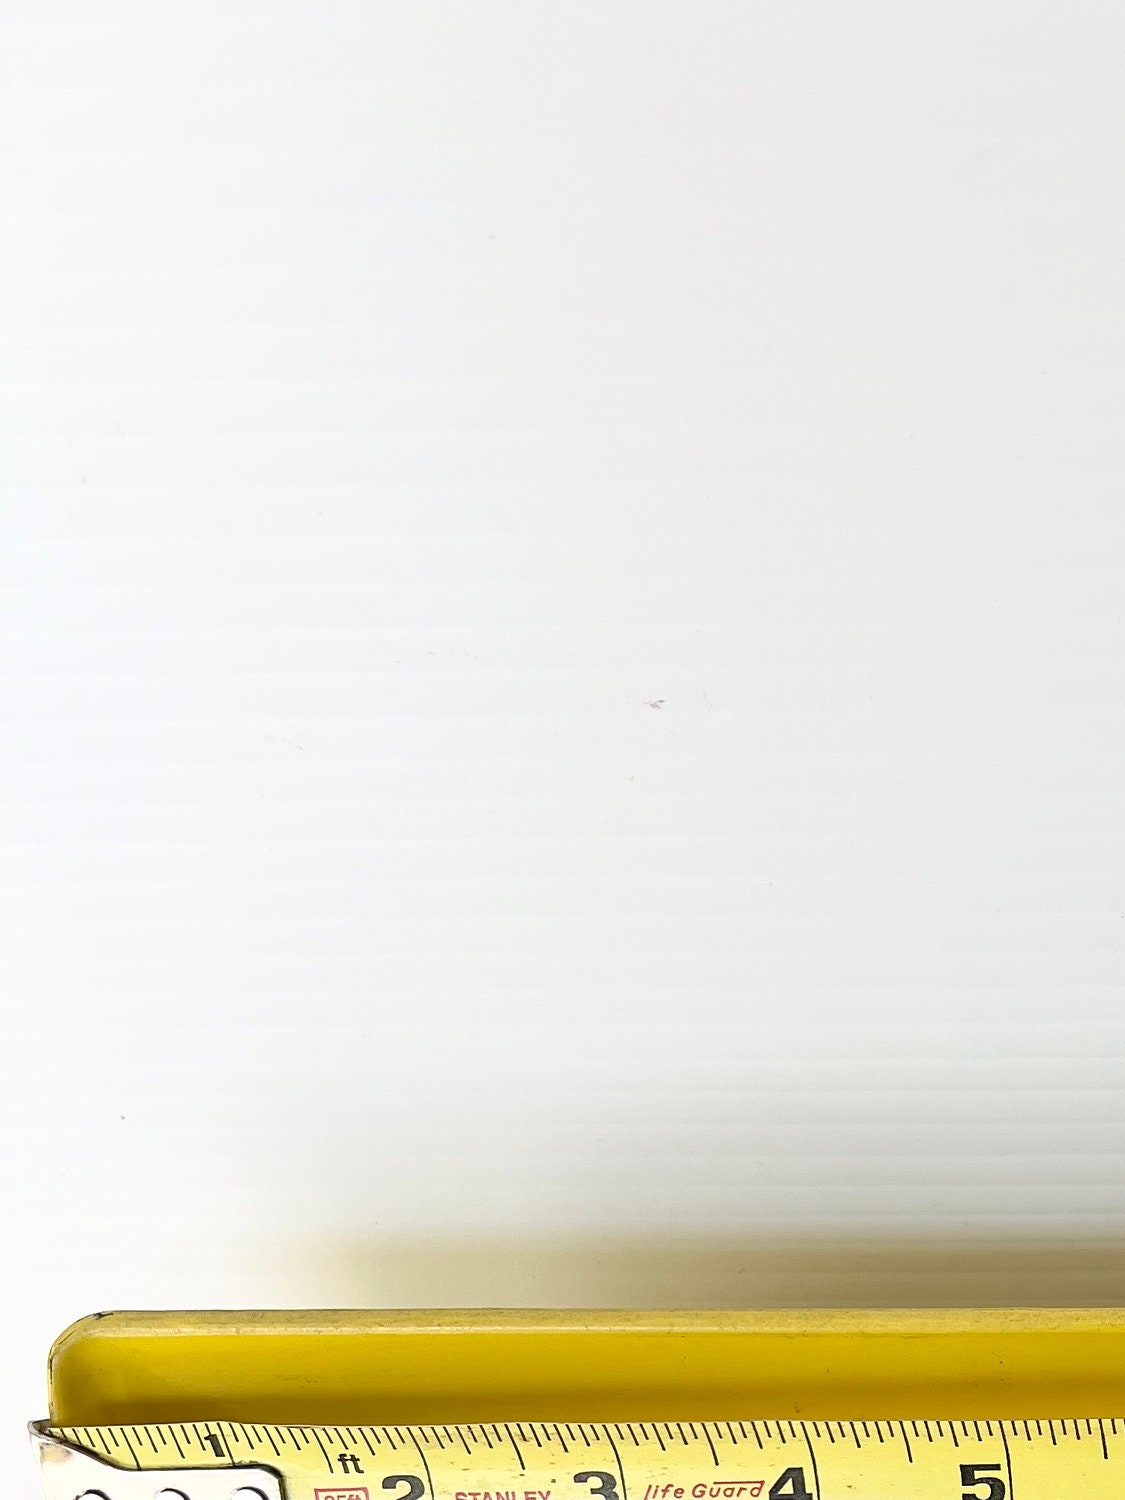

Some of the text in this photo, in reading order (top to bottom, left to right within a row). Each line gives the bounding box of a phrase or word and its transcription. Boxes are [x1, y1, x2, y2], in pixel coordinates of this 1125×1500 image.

[204, 1434, 226, 1458] 1
[337, 1453, 365, 1474] ft
[691, 1480, 766, 1499] Guard
